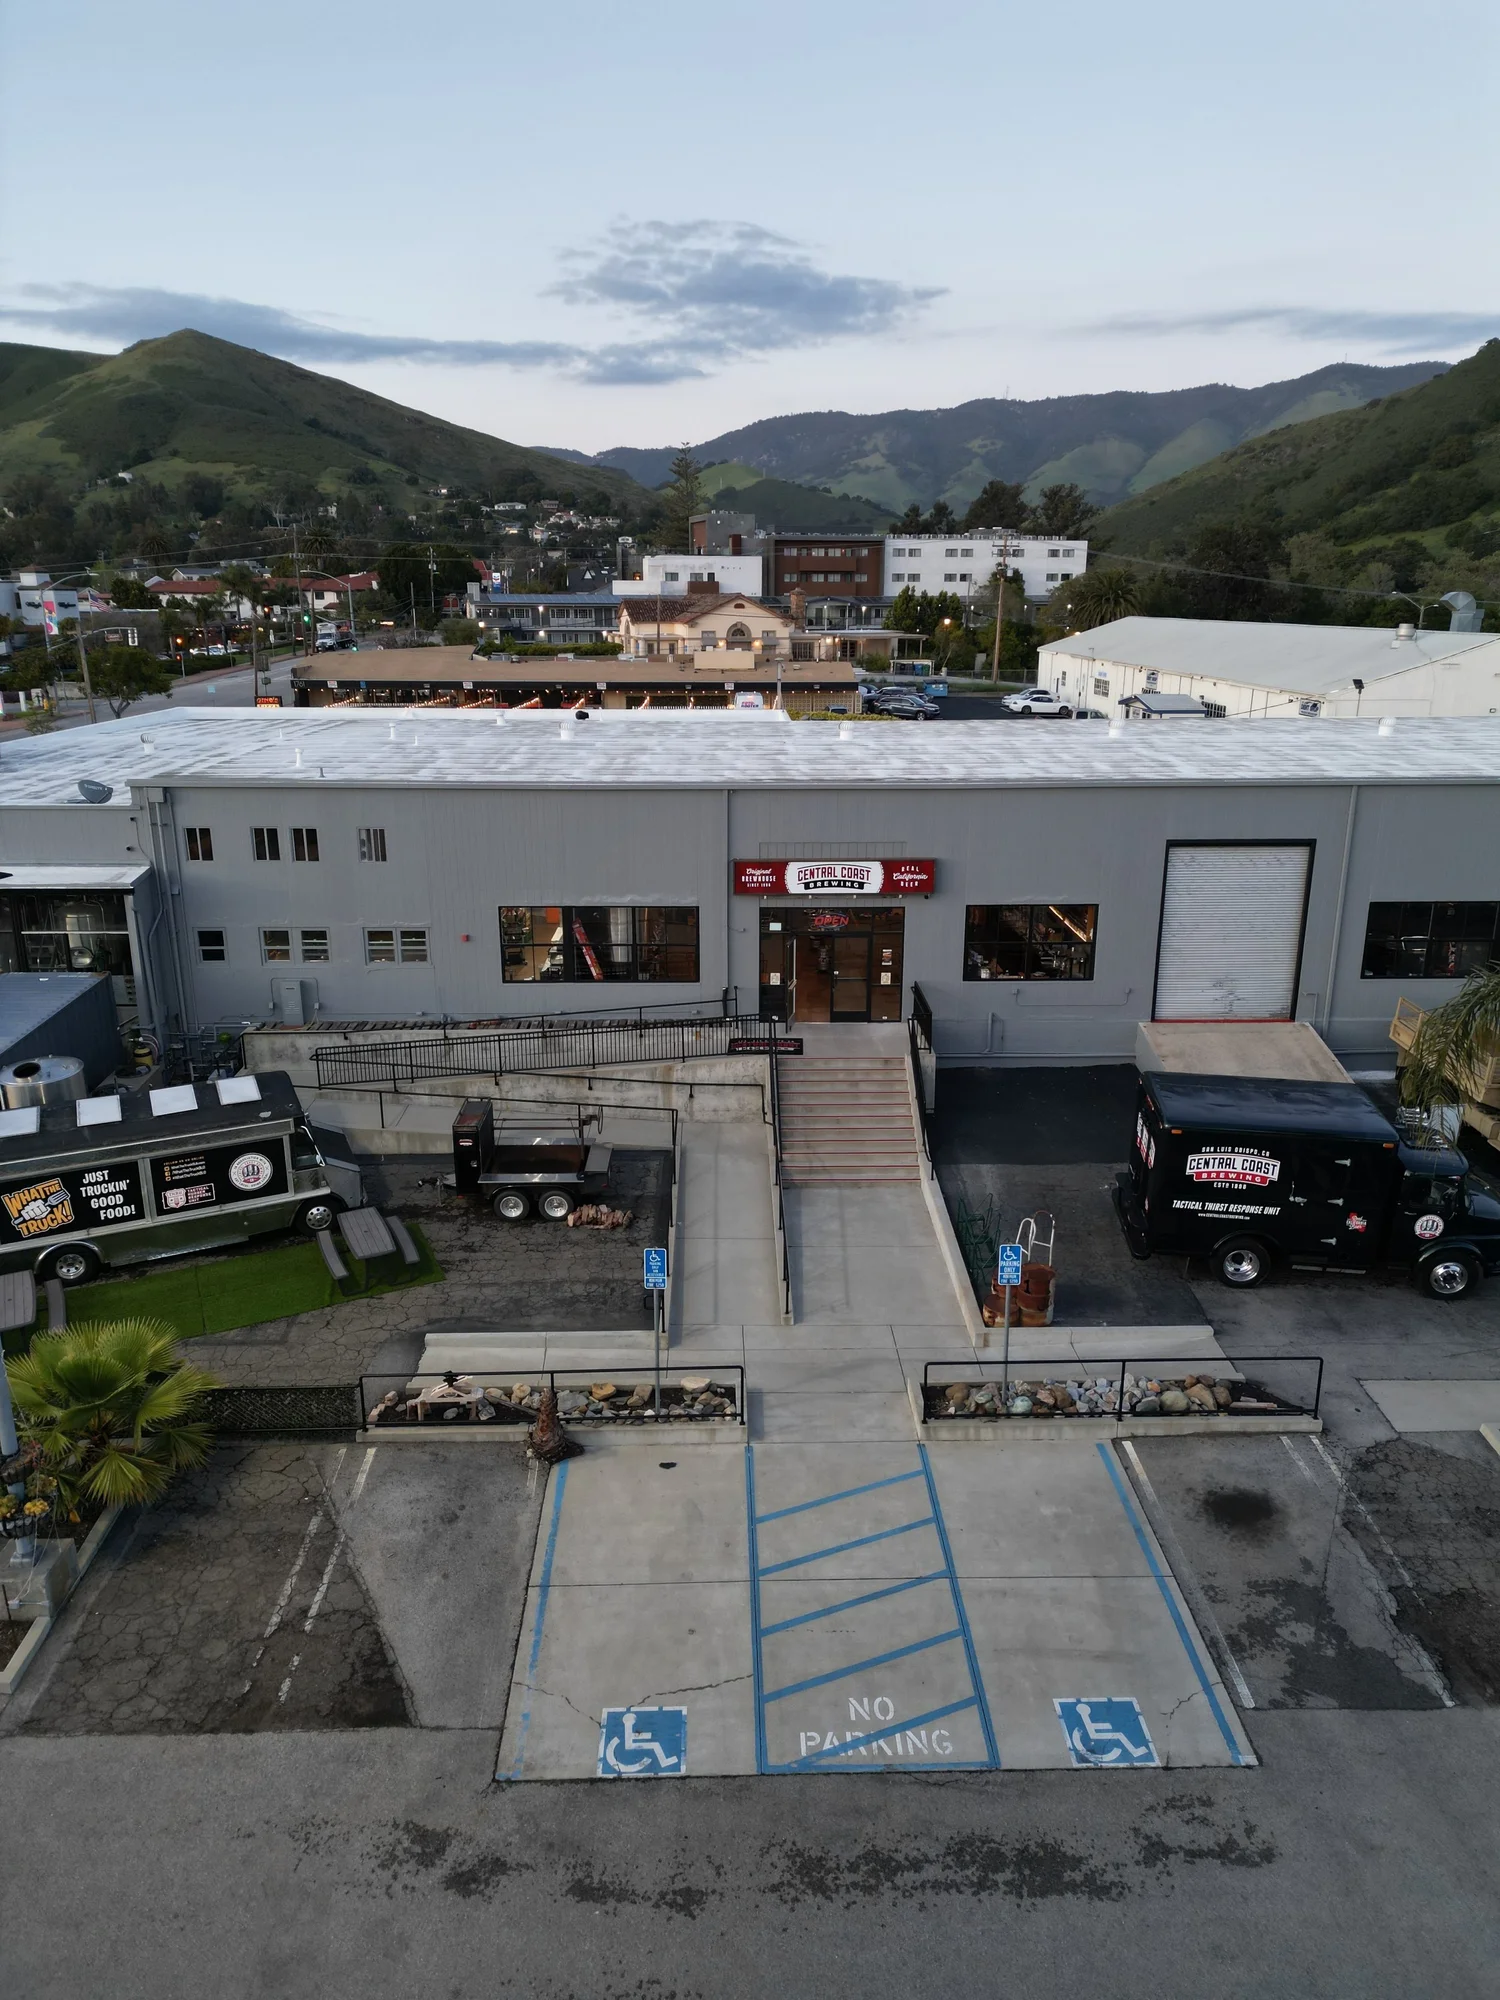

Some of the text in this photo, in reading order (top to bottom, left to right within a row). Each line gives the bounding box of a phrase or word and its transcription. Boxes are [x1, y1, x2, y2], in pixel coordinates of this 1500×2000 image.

[797, 866, 872, 882] CENTRAL COAST
[892, 872, 928, 881] California
[809, 881, 859, 889] BREWING
[814, 915, 849, 926] OPEN
[1189, 1157, 1278, 1176] CENTRAL COAST
[82, 1170, 109, 1184] JUST
[1201, 1172, 1261, 1182] BREWING
[80, 1179, 130, 1197] TRUCKIN'
[4, 1181, 61, 1218] WHAT THE
[90, 1194, 124, 1209] GOOD
[99, 1205, 136, 1220] FOOD!
[1172, 1200, 1281, 1216] TACTICAL THIRST RESPONSE UNIT
[18, 1200, 73, 1236] TRUCK!
[848, 1696, 895, 1721] NO
[799, 1729, 954, 1756] PARKING
